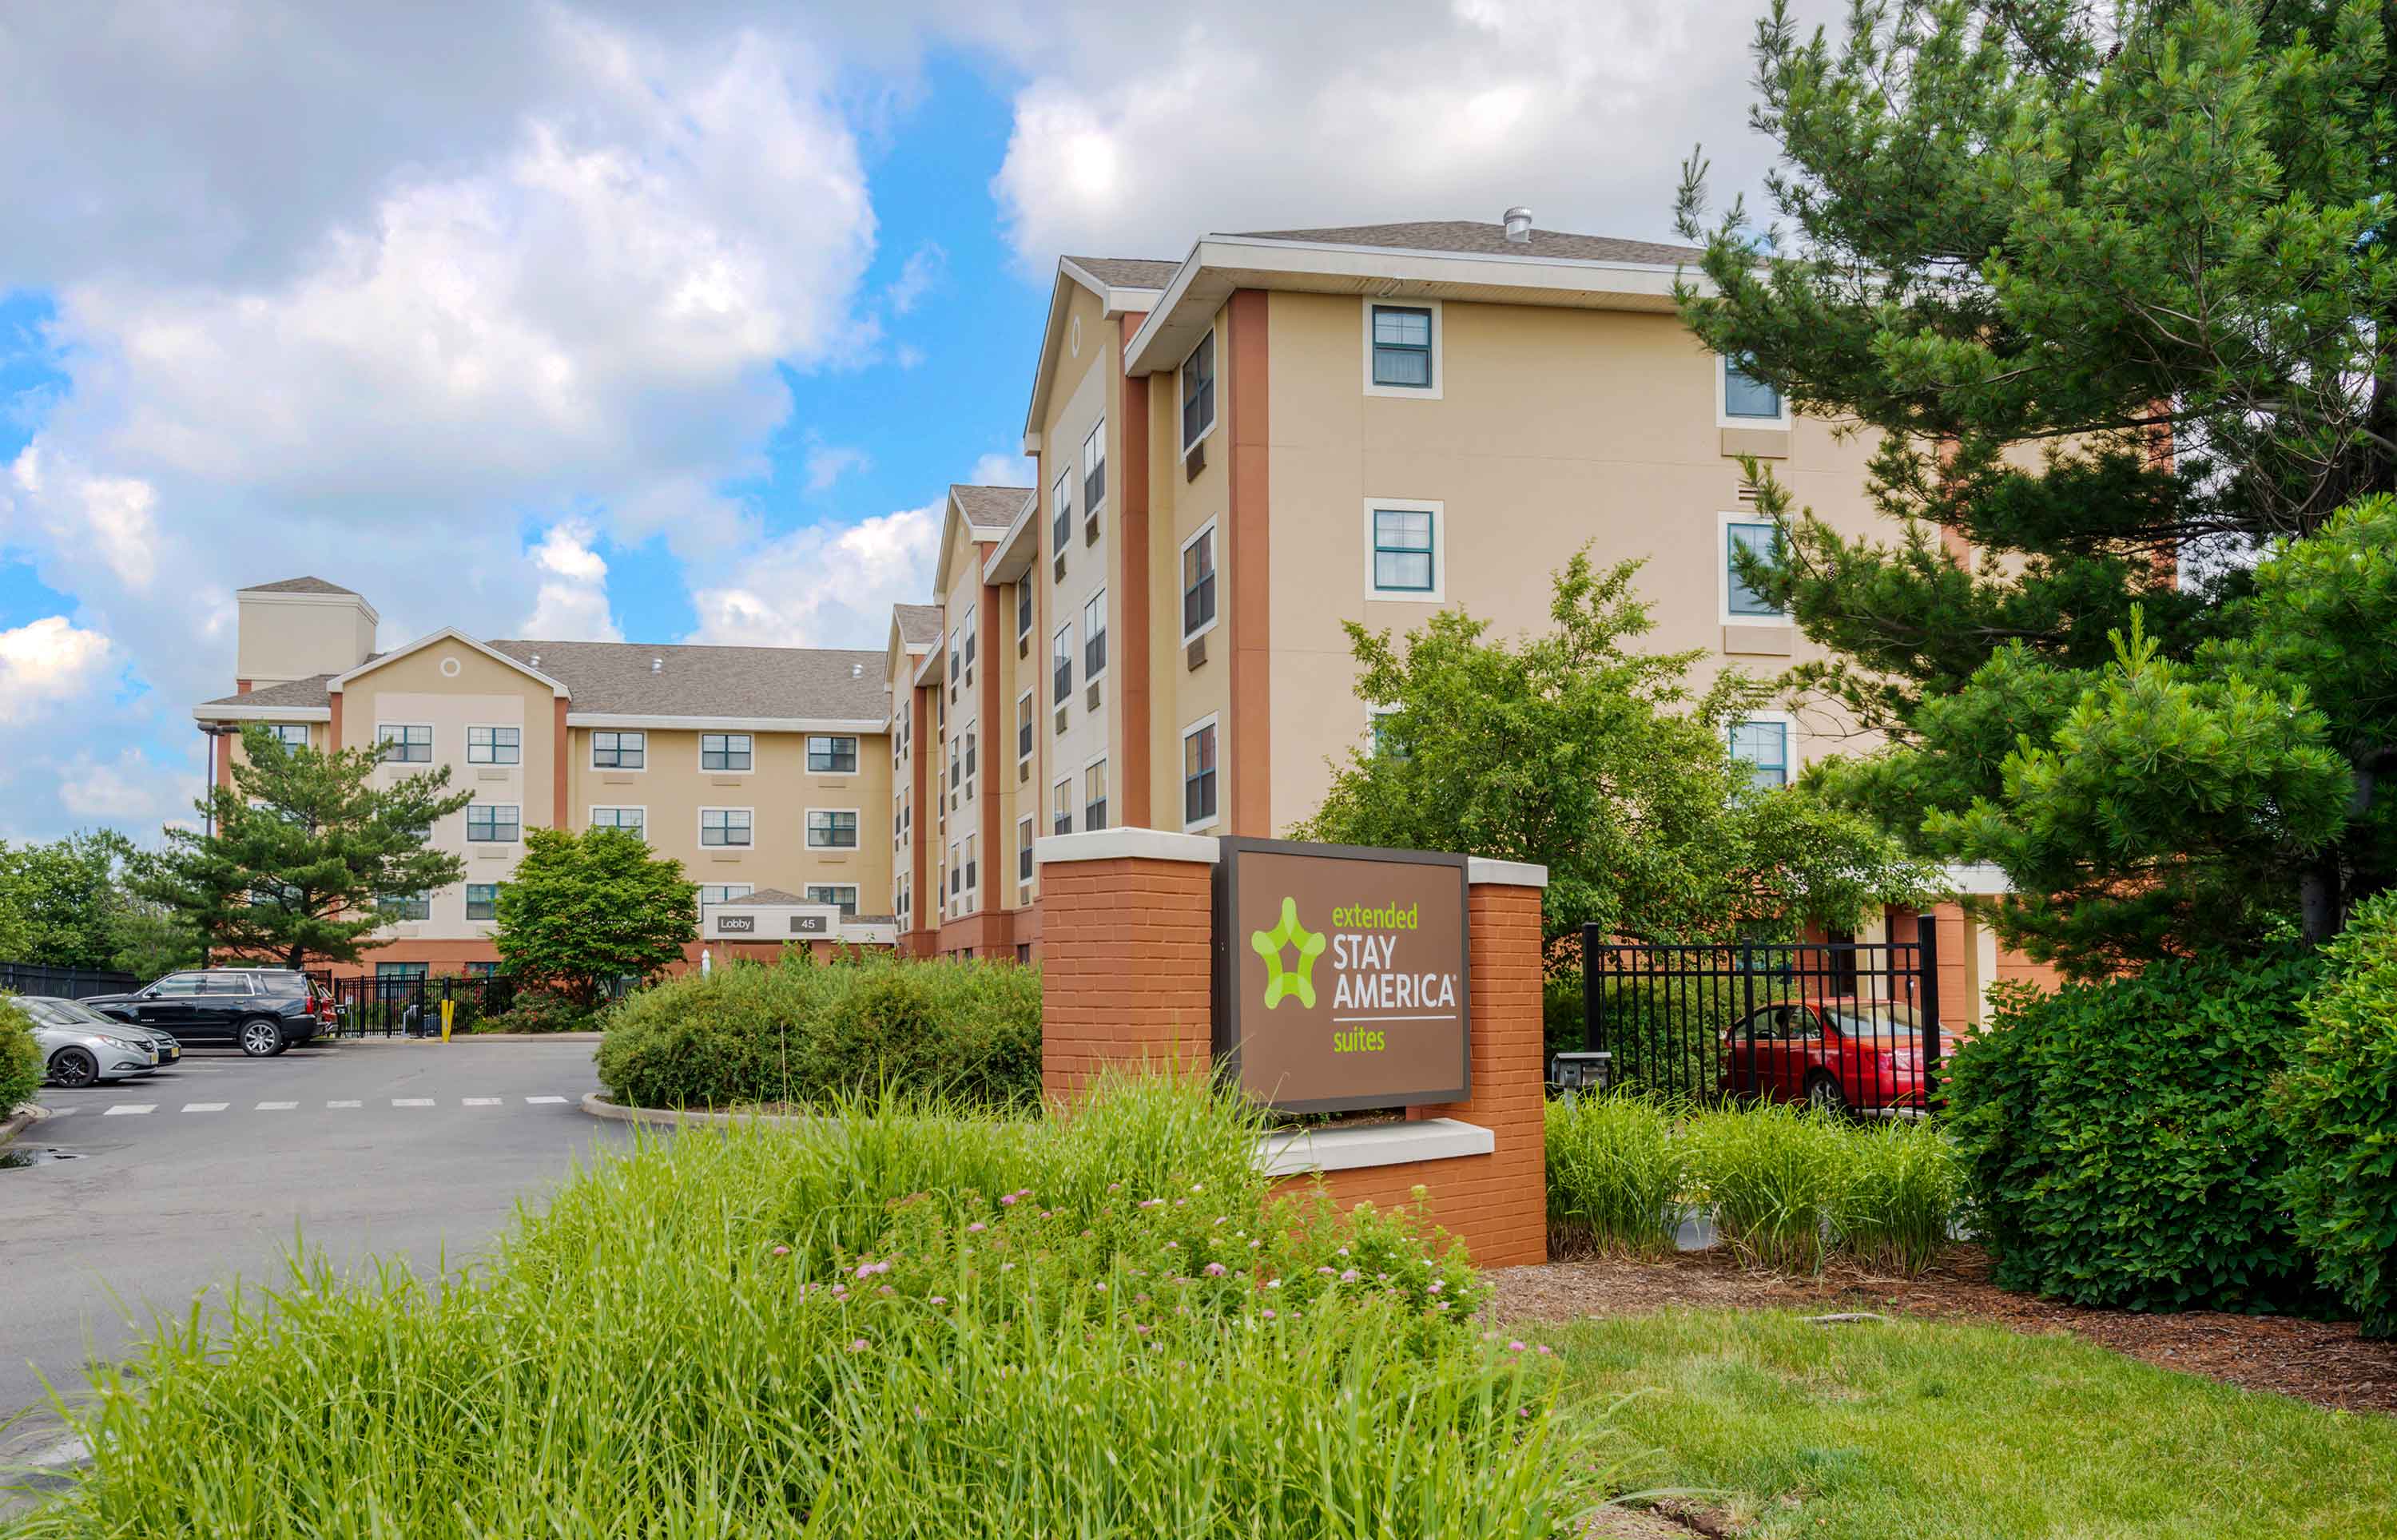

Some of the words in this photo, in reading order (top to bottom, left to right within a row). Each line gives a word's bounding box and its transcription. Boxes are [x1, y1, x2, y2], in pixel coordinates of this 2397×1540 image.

[721, 919, 750, 930] Lobby
[801, 919, 815, 928] 45
[1332, 901, 1418, 929] extended
[1333, 934, 1397, 970] STAY
[1333, 974, 1456, 1009] AMERICA
[1333, 1026, 1385, 1053] suites
